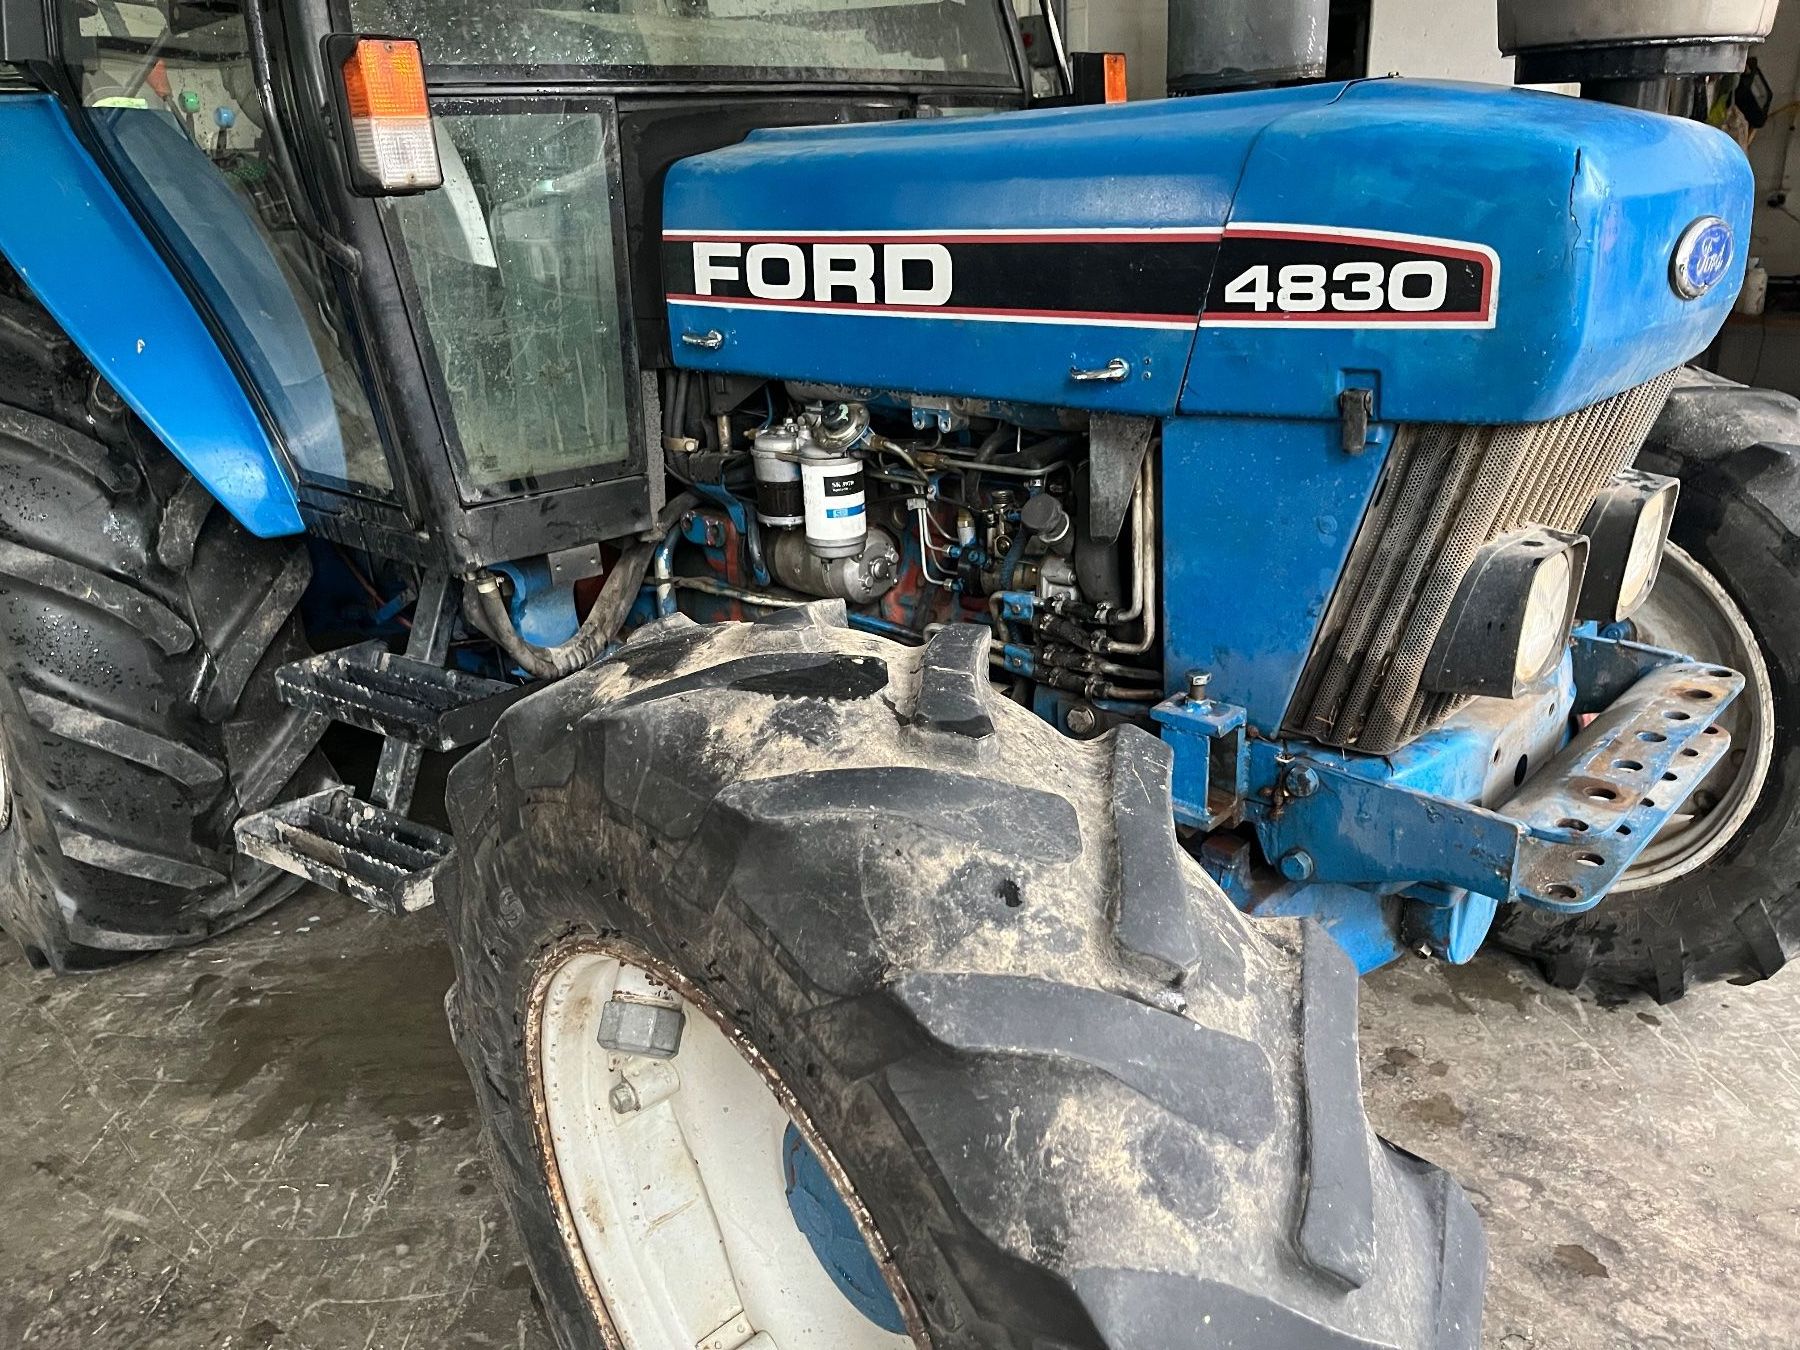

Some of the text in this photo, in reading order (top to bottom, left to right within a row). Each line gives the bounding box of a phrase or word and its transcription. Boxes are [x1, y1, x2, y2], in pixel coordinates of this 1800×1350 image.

[693, 242, 952, 306] FORD
[1697, 232, 1730, 277] Ford
[1224, 260, 1448, 312] 4830
